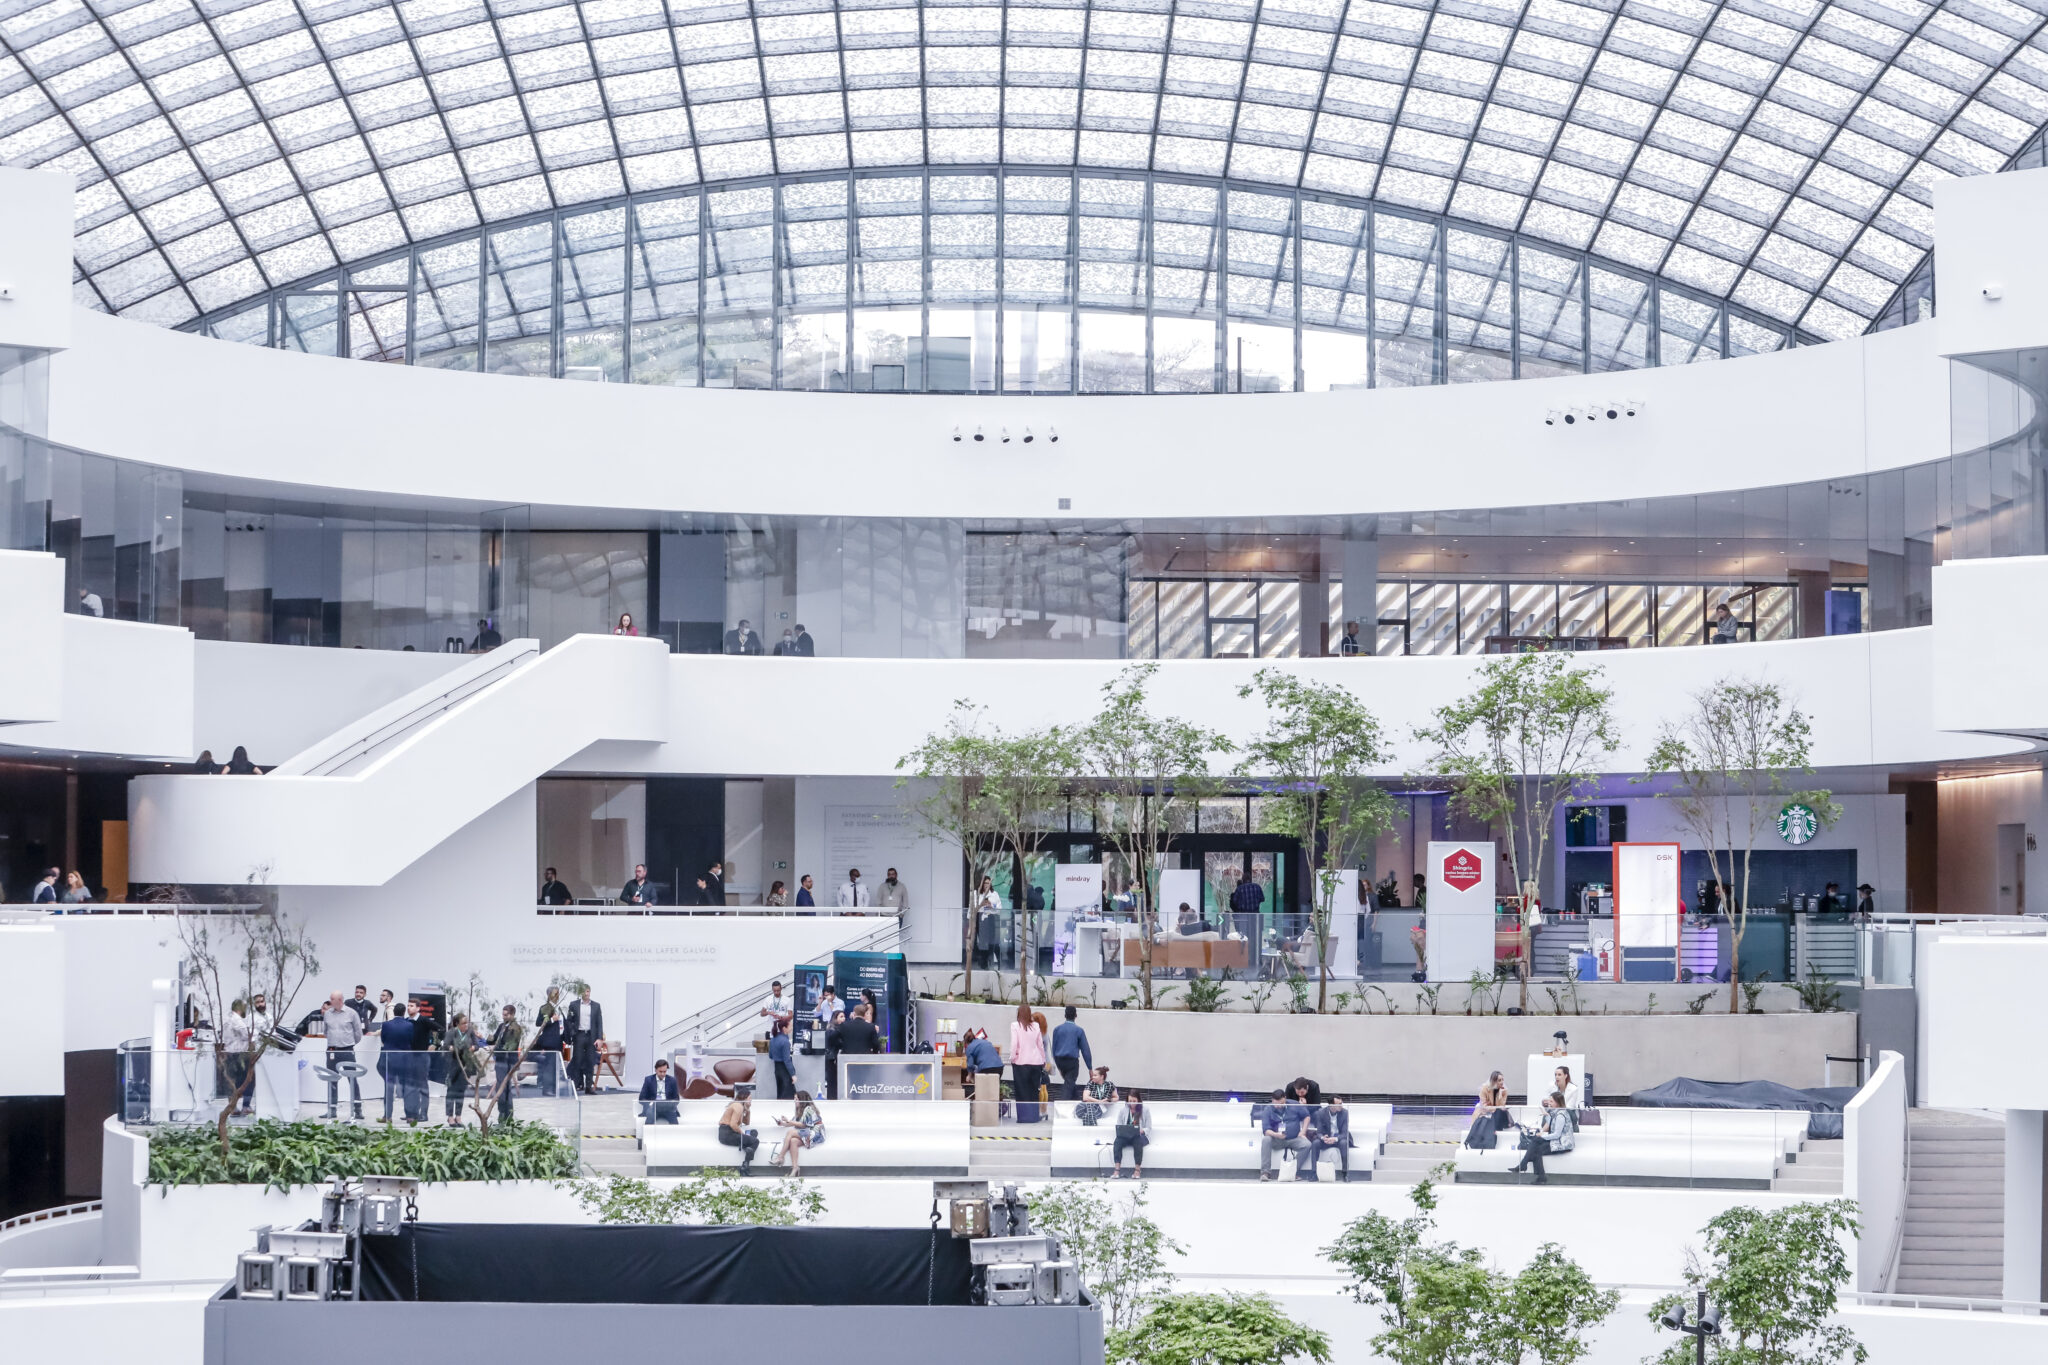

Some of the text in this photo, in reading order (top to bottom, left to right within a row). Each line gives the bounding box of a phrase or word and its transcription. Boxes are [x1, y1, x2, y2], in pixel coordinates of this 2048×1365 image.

[1065, 875, 1091, 883] mindray
[512, 947, 544, 955] ESPAÇO
[682, 946, 717, 954] GALVÃO
[849, 1083, 915, 1094] AstraZeneca
